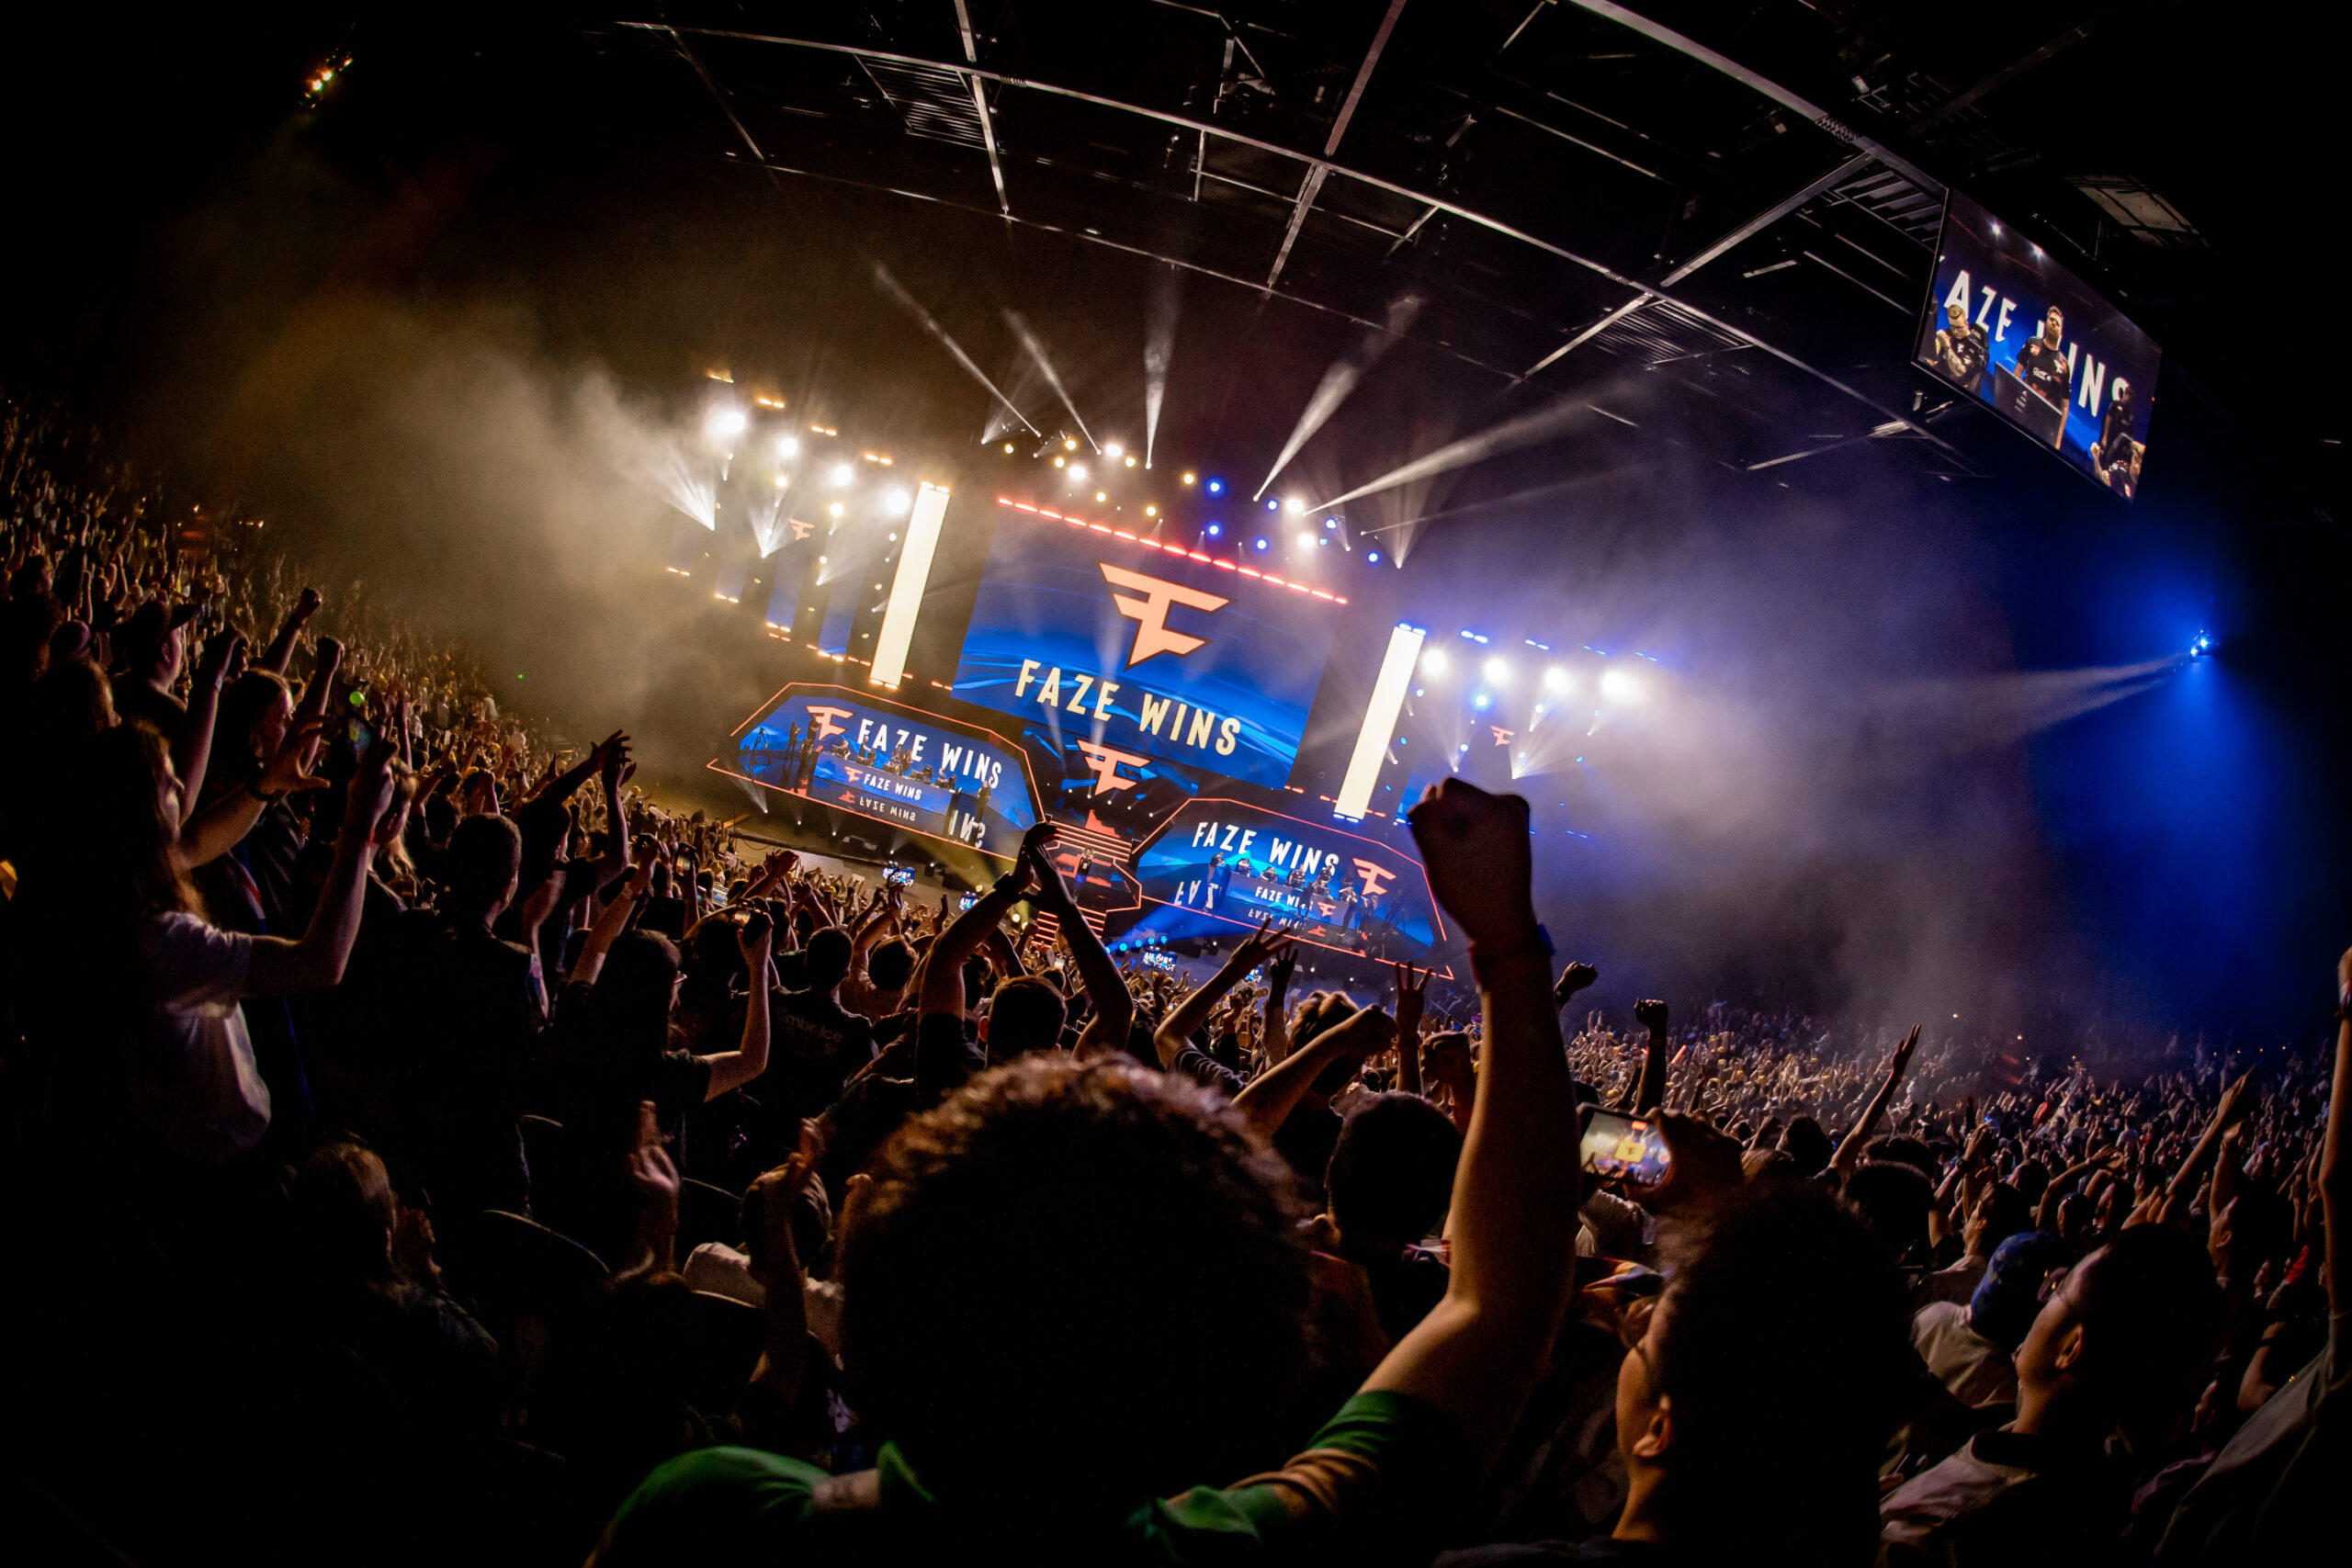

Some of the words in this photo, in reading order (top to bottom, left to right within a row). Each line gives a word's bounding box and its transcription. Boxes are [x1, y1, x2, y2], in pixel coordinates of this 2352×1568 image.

[1015, 659, 1120, 722] FAZE
[1138, 693, 1241, 756] WINS
[856, 718, 928, 762] FAZE
[941, 742, 1003, 789] WINS
[864, 773, 891, 791] FAZE
[894, 784, 922, 801] WINS
[1192, 821, 1258, 853] FAZE
[1269, 837, 1340, 876] WINS
[1255, 886, 1283, 903] FAZE
